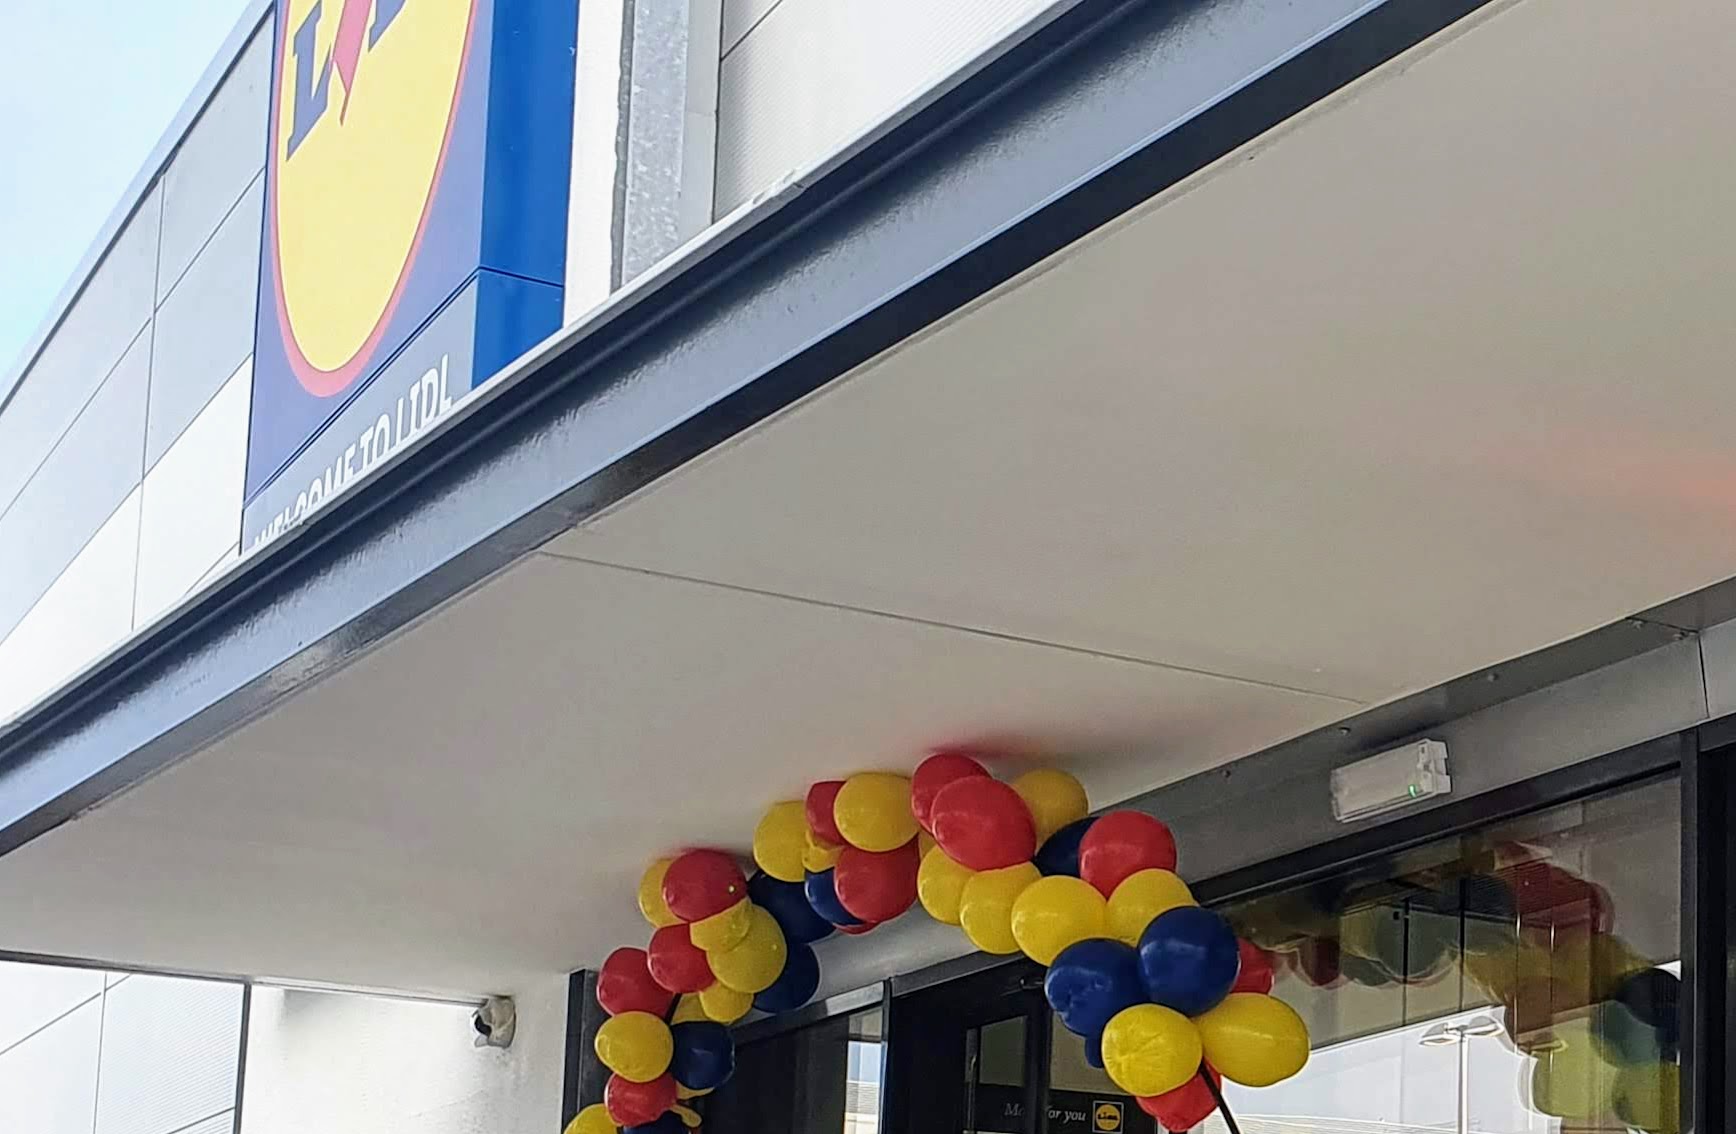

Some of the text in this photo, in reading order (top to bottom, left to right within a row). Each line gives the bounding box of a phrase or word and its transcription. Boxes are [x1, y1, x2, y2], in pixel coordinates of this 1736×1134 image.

[254, 353, 452, 545] COME TO LIDL
[1064, 1110, 1086, 1124] you
